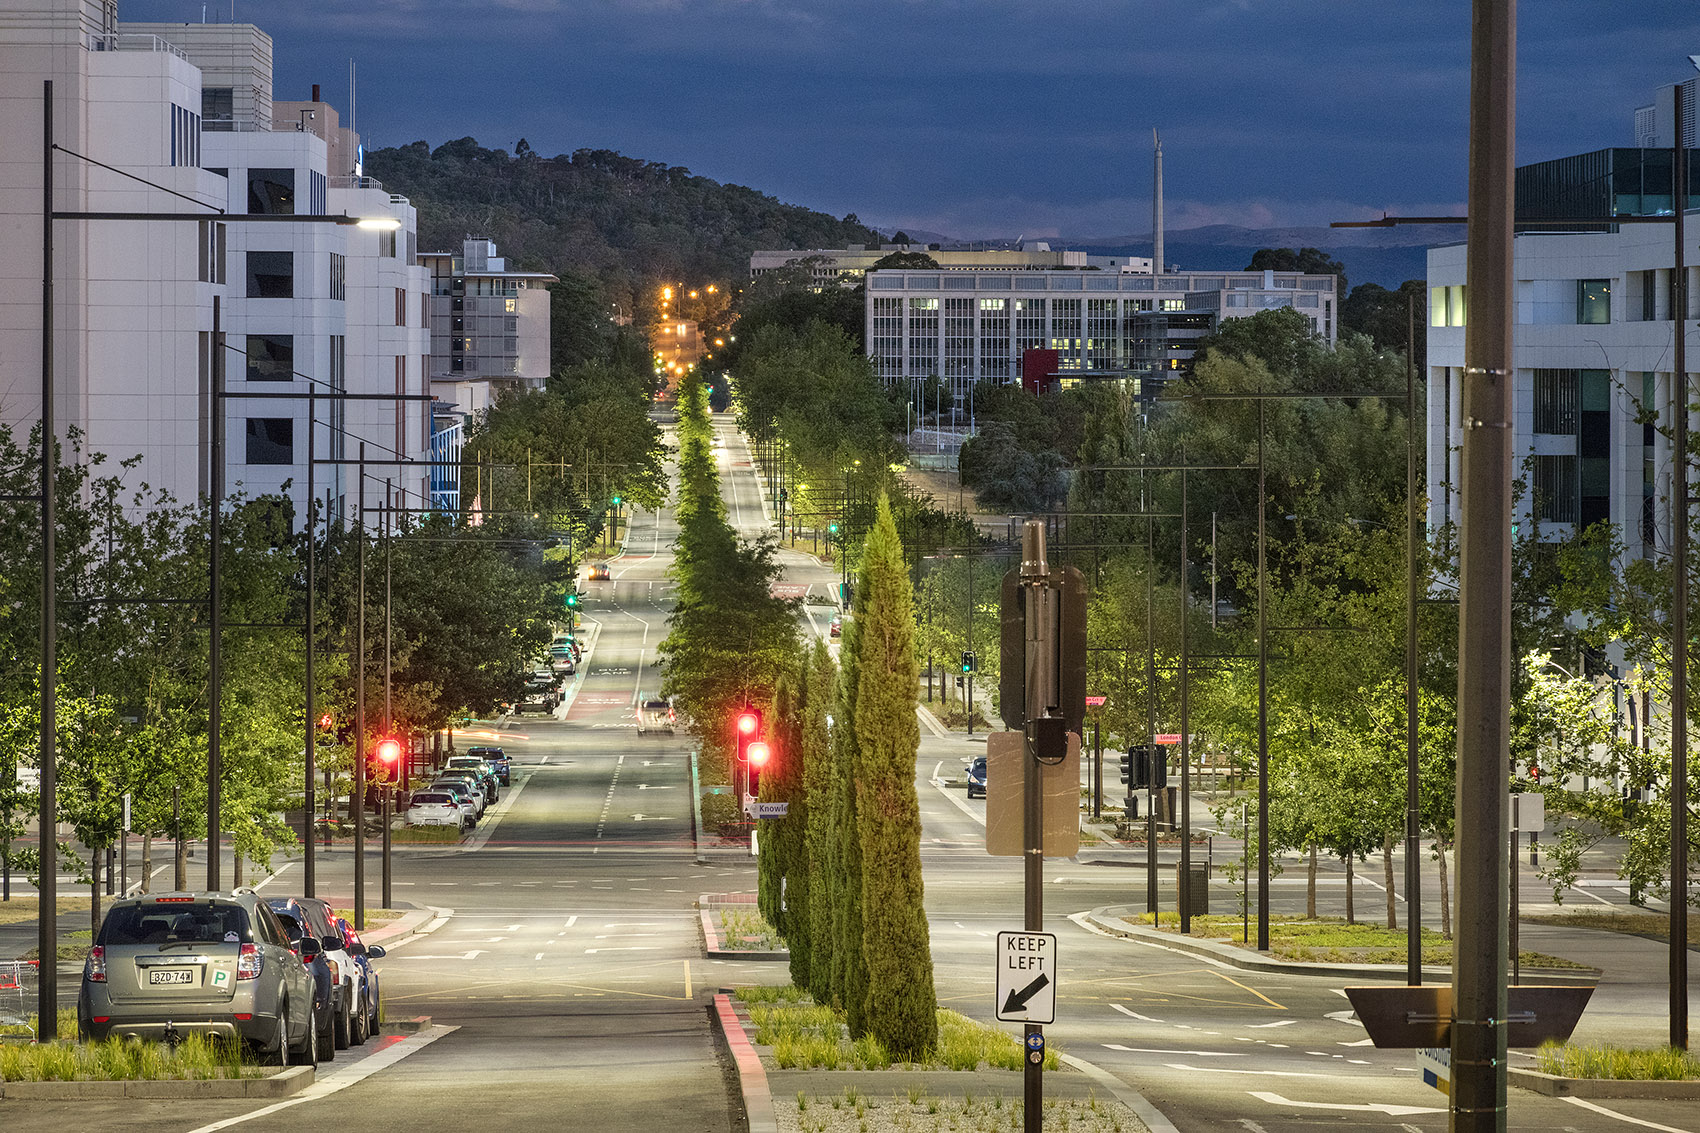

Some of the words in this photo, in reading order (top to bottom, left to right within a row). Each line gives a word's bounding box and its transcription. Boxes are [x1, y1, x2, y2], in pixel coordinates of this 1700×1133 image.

[1007, 937, 1046, 951] KEEP
[1009, 955, 1044, 970] LEFT
[214, 971, 226, 984] P
